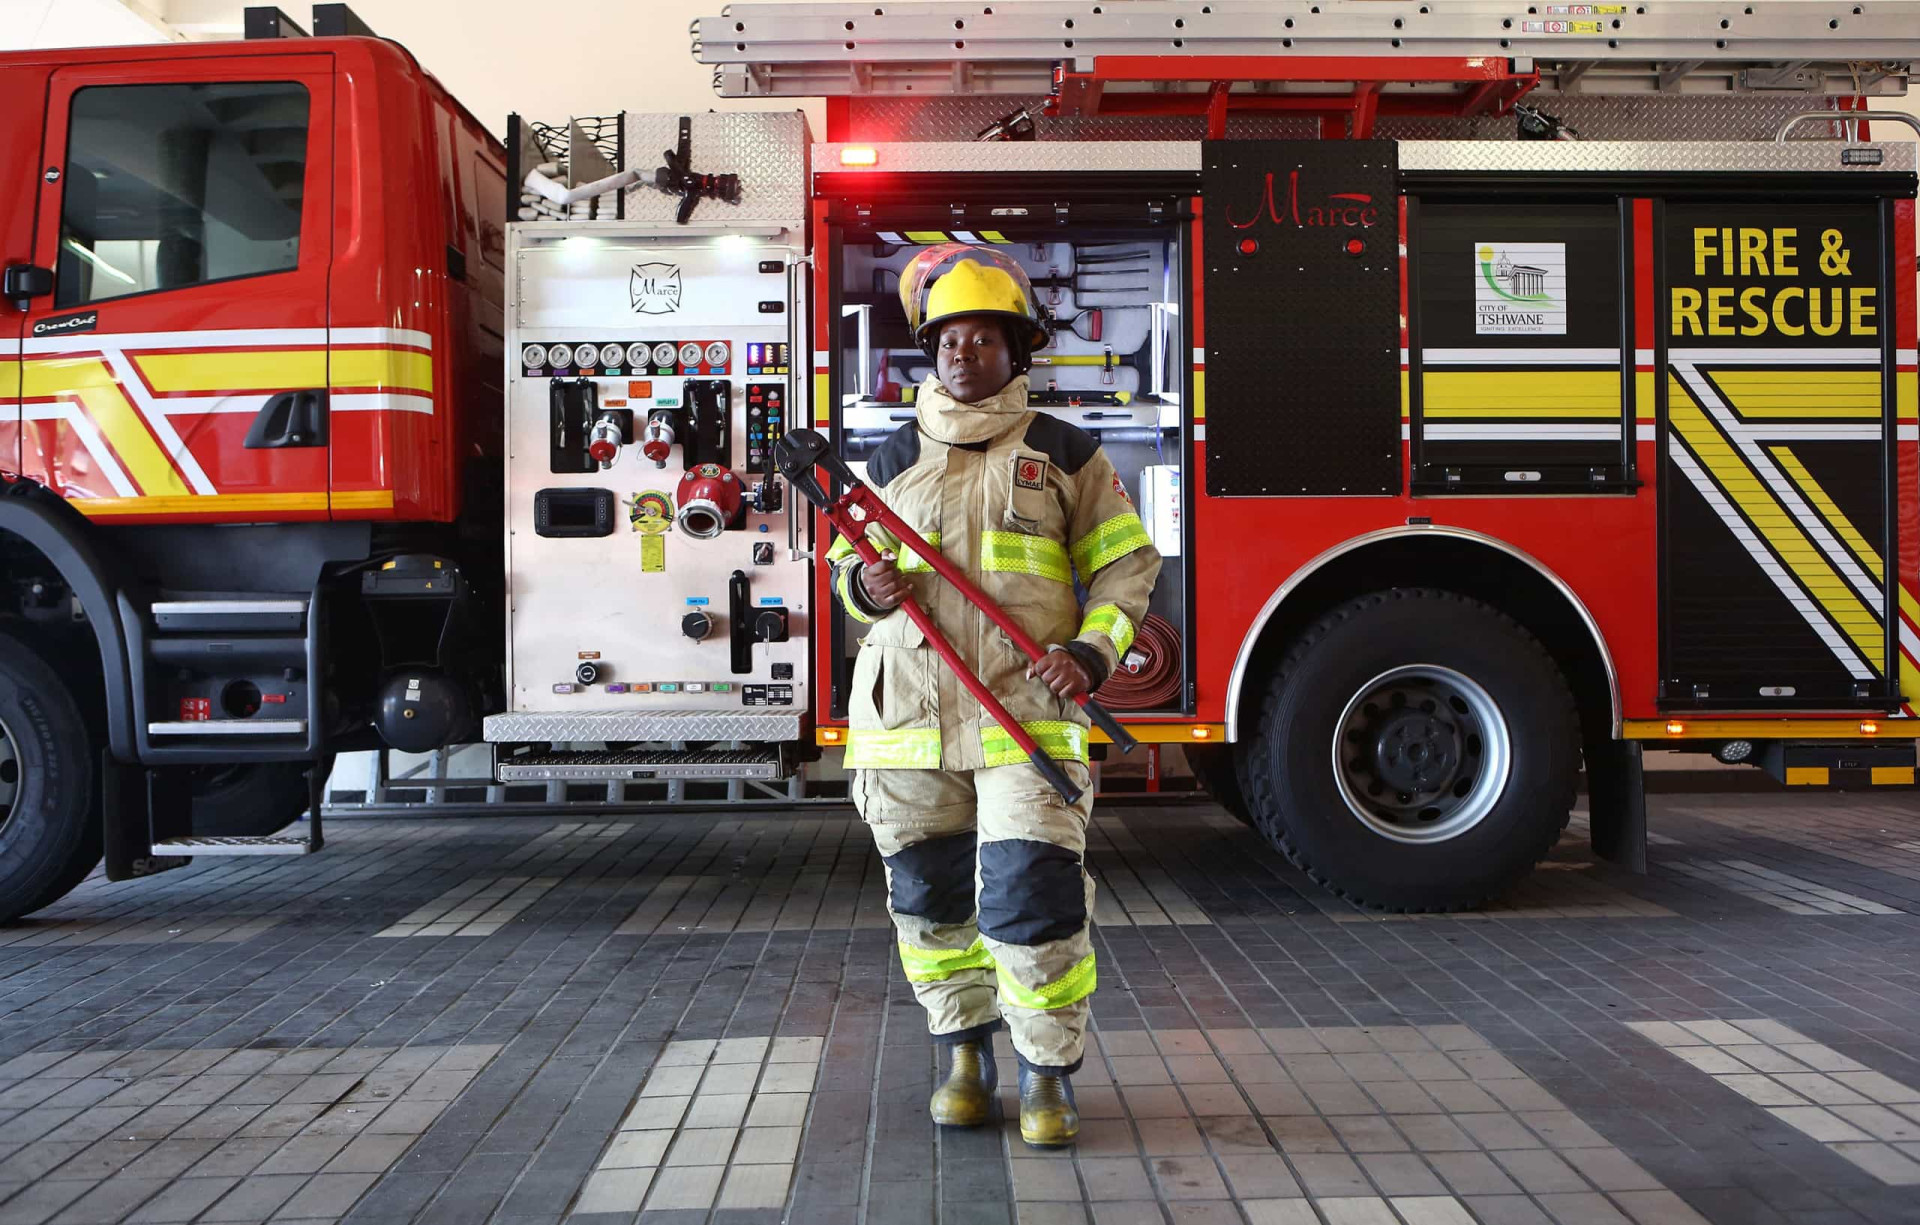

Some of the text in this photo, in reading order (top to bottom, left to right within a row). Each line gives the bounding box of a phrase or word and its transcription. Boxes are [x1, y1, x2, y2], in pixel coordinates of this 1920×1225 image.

[1693, 227, 1853, 277] FIRE &
[1479, 314, 1544, 325] TSHWANE
[1671, 286, 1878, 337] RESCUE
